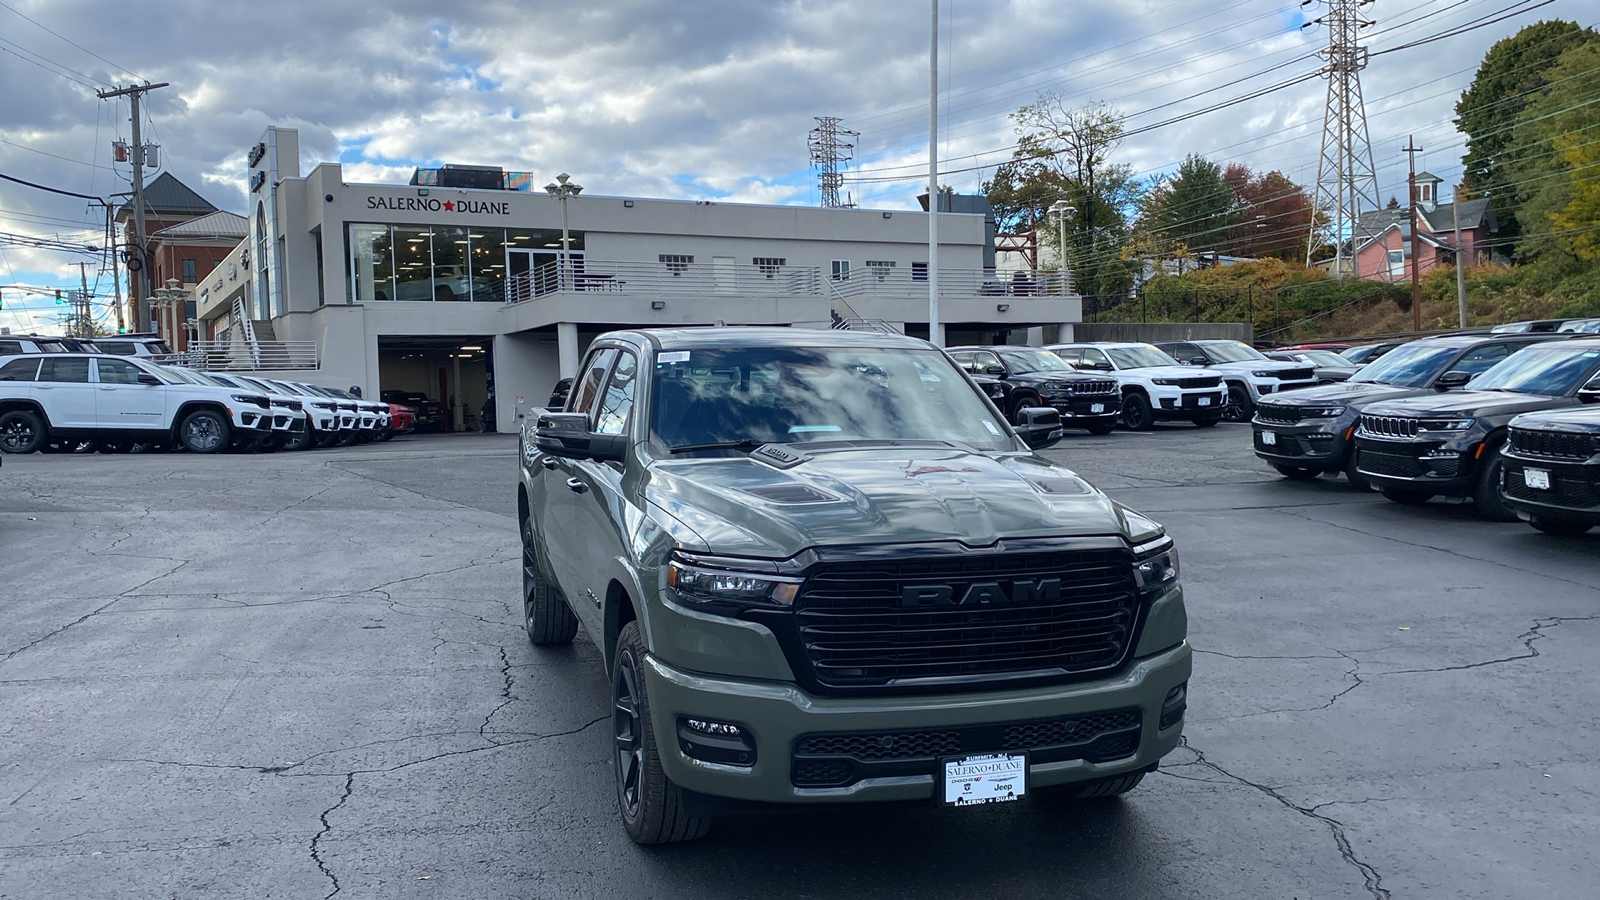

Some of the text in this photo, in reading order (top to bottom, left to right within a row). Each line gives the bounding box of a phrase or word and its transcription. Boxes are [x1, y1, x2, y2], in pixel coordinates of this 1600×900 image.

[367, 196, 510, 214] SALERNO DUANE
[902, 578, 1061, 607] RAM
[947, 766, 988, 776] SALERNO
[992, 761, 1022, 772] DUANE
[994, 784, 1013, 792] Jeep
[954, 794, 1018, 807] SALERNO DUANE
